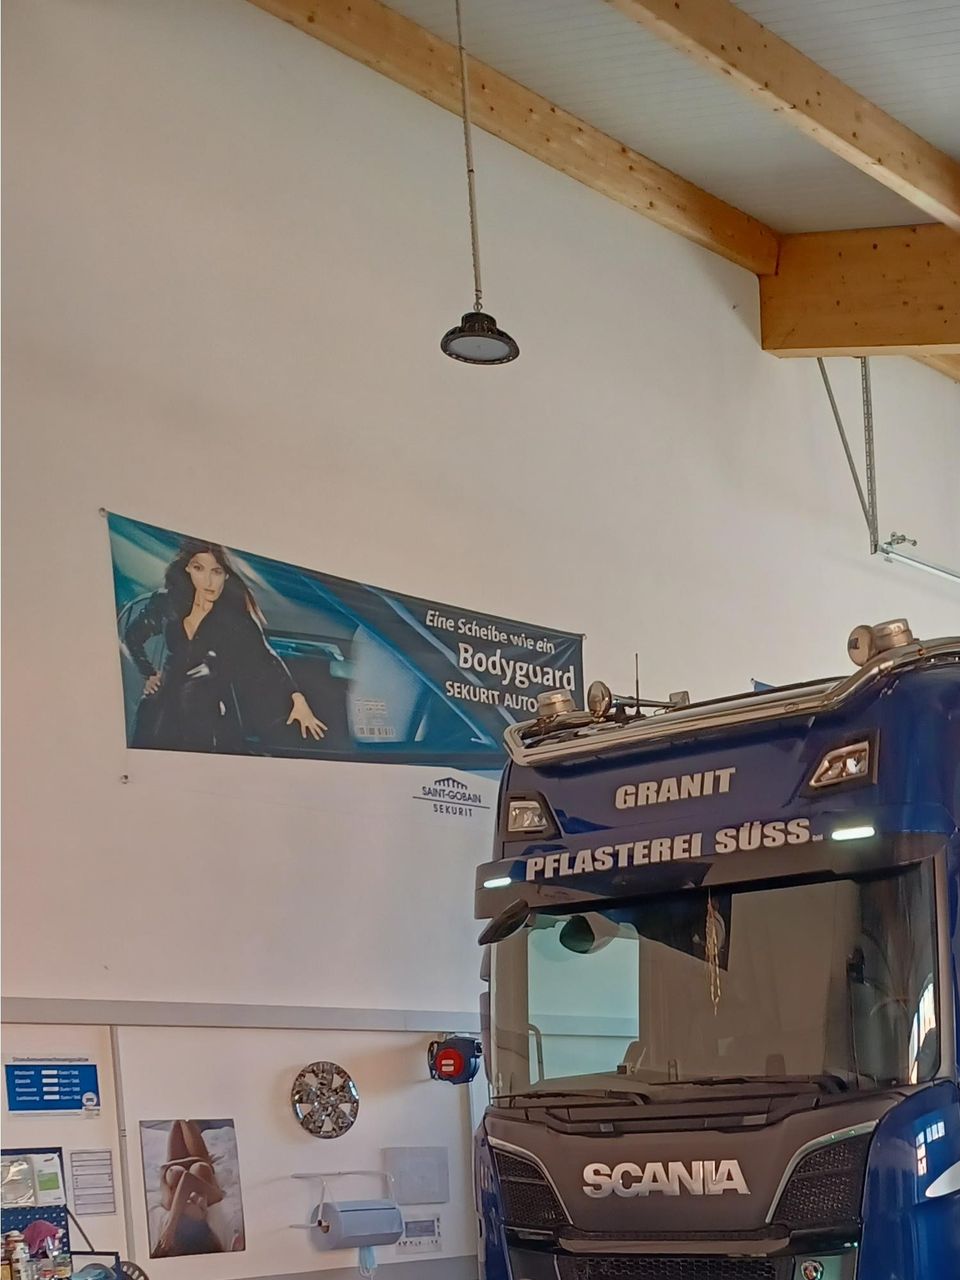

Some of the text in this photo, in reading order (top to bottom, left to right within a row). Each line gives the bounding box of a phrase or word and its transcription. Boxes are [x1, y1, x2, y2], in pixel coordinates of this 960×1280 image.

[425, 609, 555, 655] Eine Scheibe wie ein
[457, 642, 576, 692] Bodyguard
[445, 680, 500, 705] SEKURIT
[421, 785, 481, 804] SAINT-GOBAIN
[615, 767, 737, 810] GRANIT
[432, 803, 473, 817] SEKURIT
[525, 818, 811, 882] PFLASTEREI SÜSS
[582, 1158, 751, 1199] SCANIA
